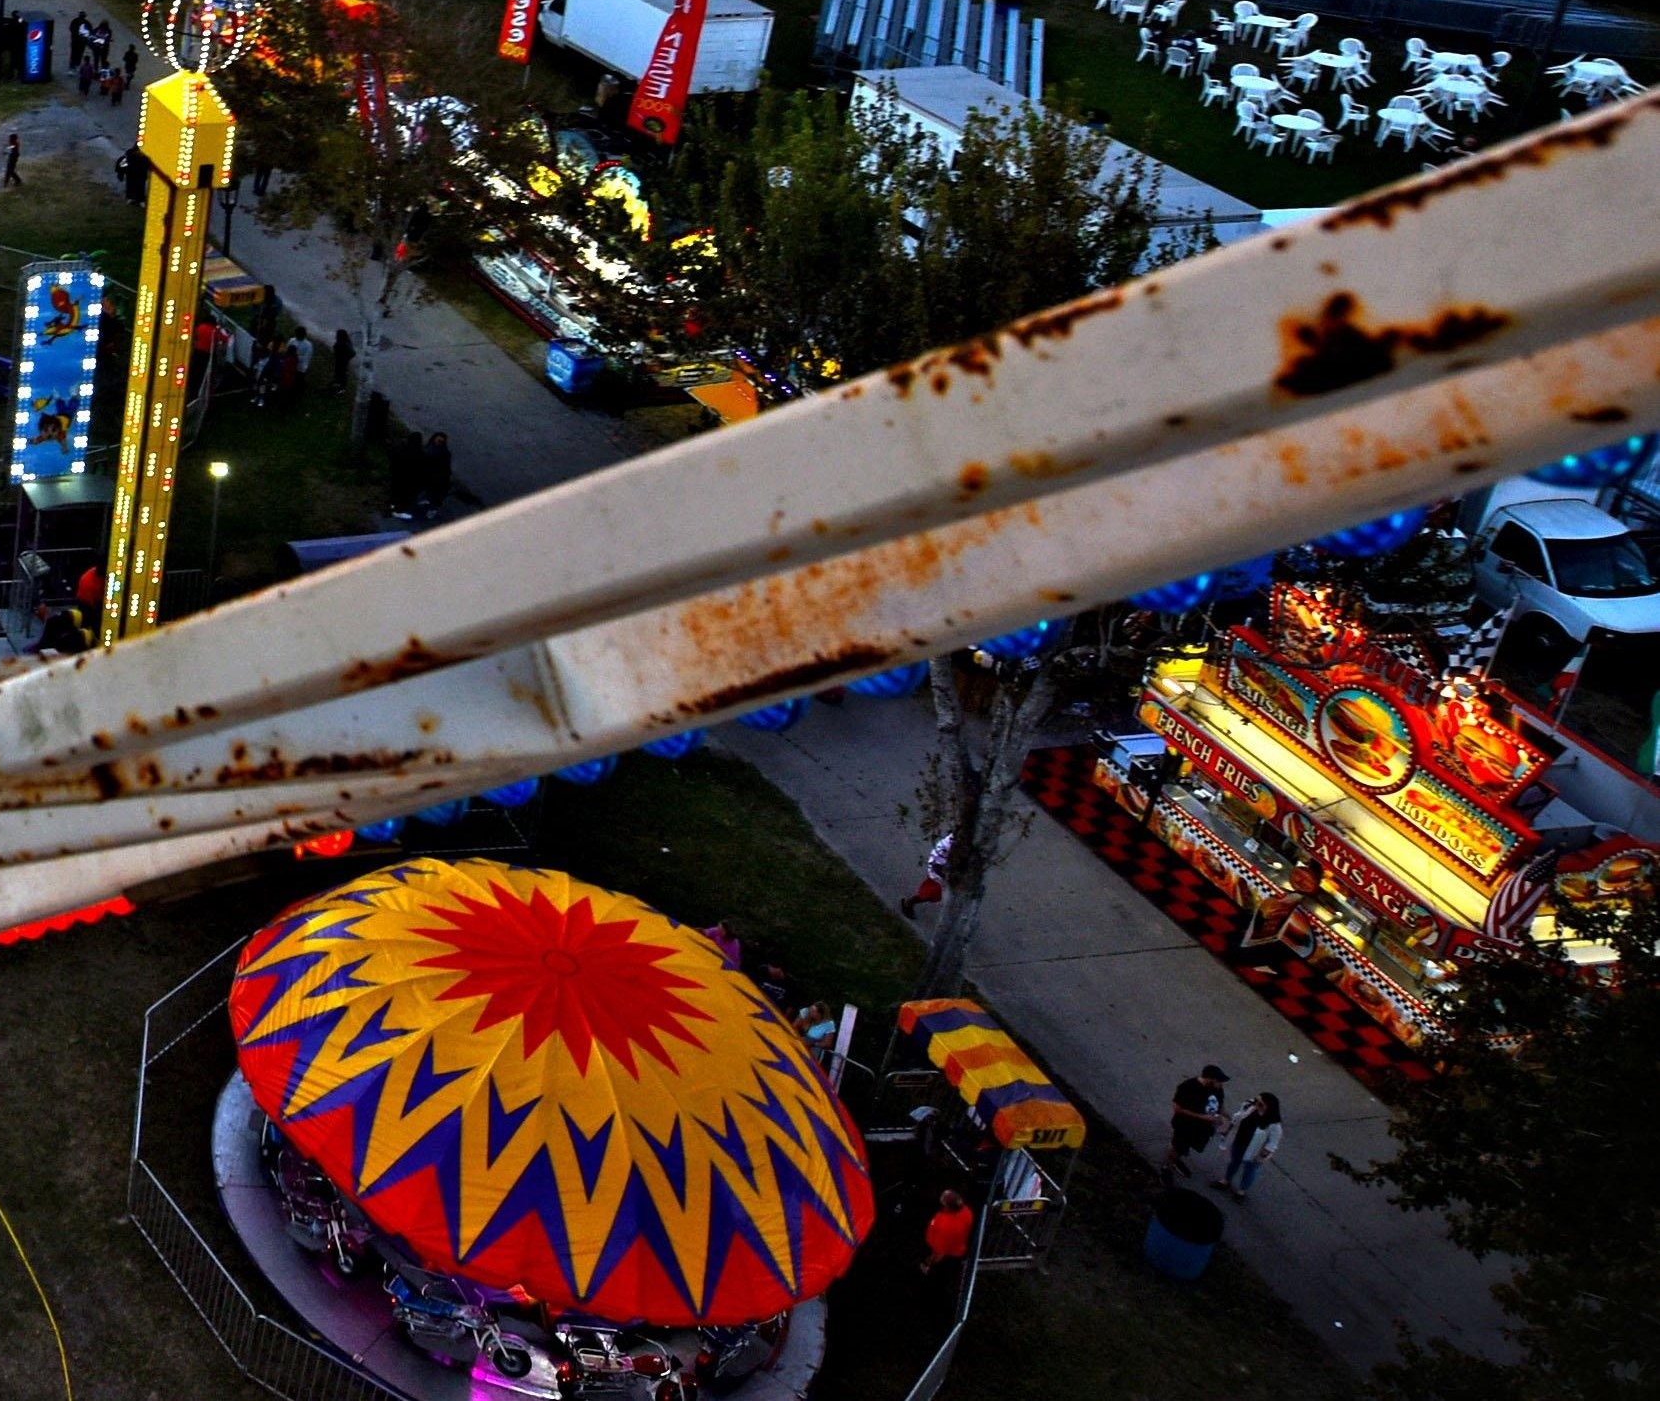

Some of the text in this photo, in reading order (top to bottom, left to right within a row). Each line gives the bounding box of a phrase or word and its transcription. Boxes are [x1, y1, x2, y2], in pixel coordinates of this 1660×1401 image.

[1231, 677, 1309, 740] SAUSAGE
[1157, 709, 1261, 804] FRENCH FRIES
[1396, 796, 1486, 869] HOT DOGS
[1300, 830, 1418, 928] SAUSAGE
[1032, 1128, 1068, 1144] EXIT
